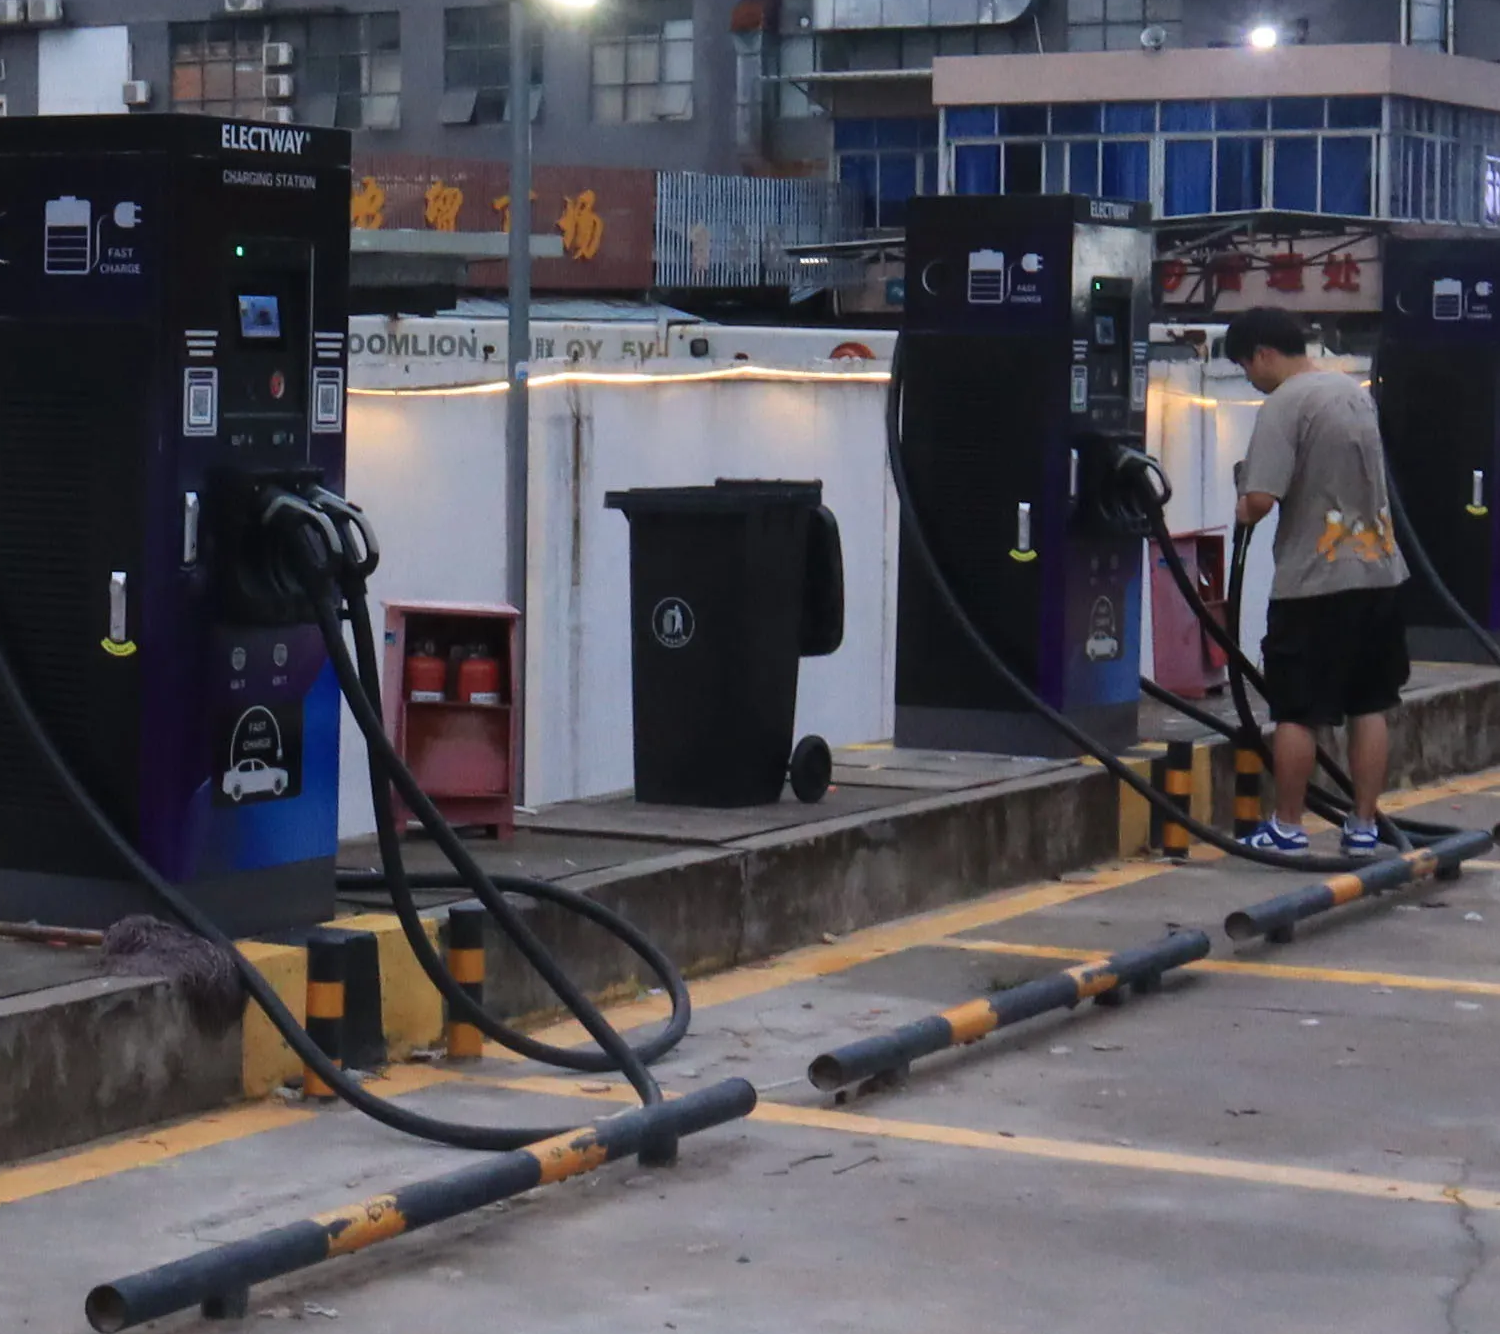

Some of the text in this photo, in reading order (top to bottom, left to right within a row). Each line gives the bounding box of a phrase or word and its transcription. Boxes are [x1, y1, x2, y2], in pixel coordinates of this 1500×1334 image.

[223, 169, 316, 190] CHARGING STATION
[107, 247, 134, 259] FAST
[100, 263, 141, 275] CHARGE
[348, 332, 478, 358] OOMLION
